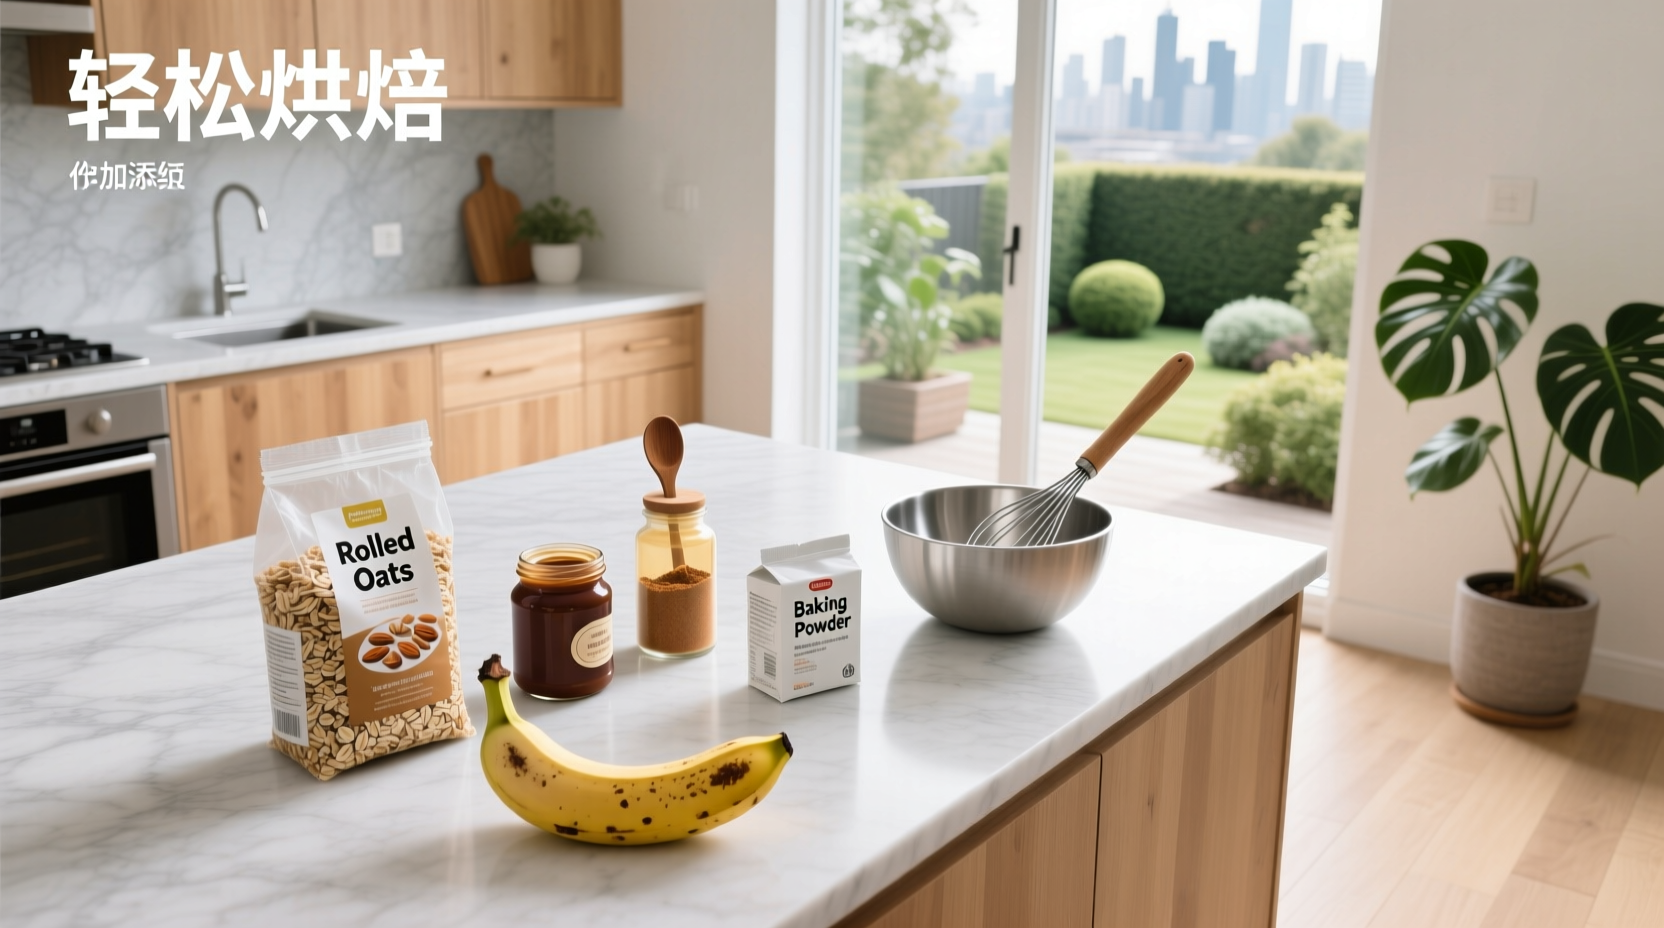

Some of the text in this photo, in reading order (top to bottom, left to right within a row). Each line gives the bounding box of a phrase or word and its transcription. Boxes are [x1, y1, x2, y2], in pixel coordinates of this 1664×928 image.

[335, 526, 415, 565] Rolled
[353, 562, 415, 592] Oats
[793, 596, 848, 618] Baking
[793, 614, 852, 638] Powder
